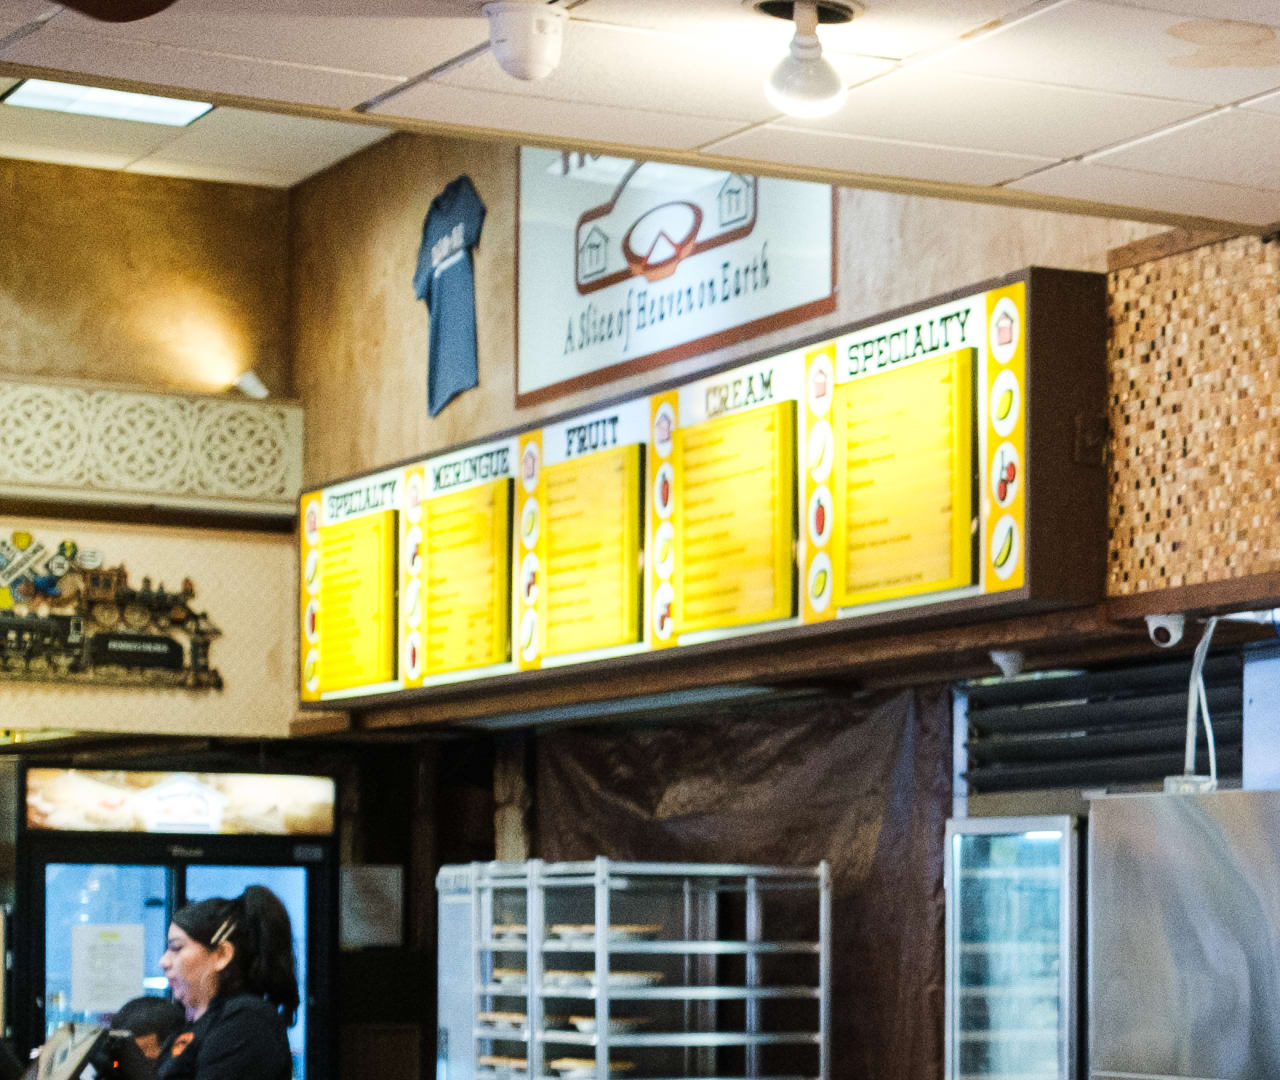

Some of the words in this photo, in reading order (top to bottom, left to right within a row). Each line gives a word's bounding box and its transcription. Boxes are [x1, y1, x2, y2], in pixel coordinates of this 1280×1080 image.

[720, 240, 771, 303] Earth
[848, 308, 972, 376] SPECIALTY
[704, 368, 775, 418] CREAM
[565, 416, 620, 457] FRUIT
[432, 447, 512, 491] MERINGUE
[327, 480, 398, 520] SPECIALTY
